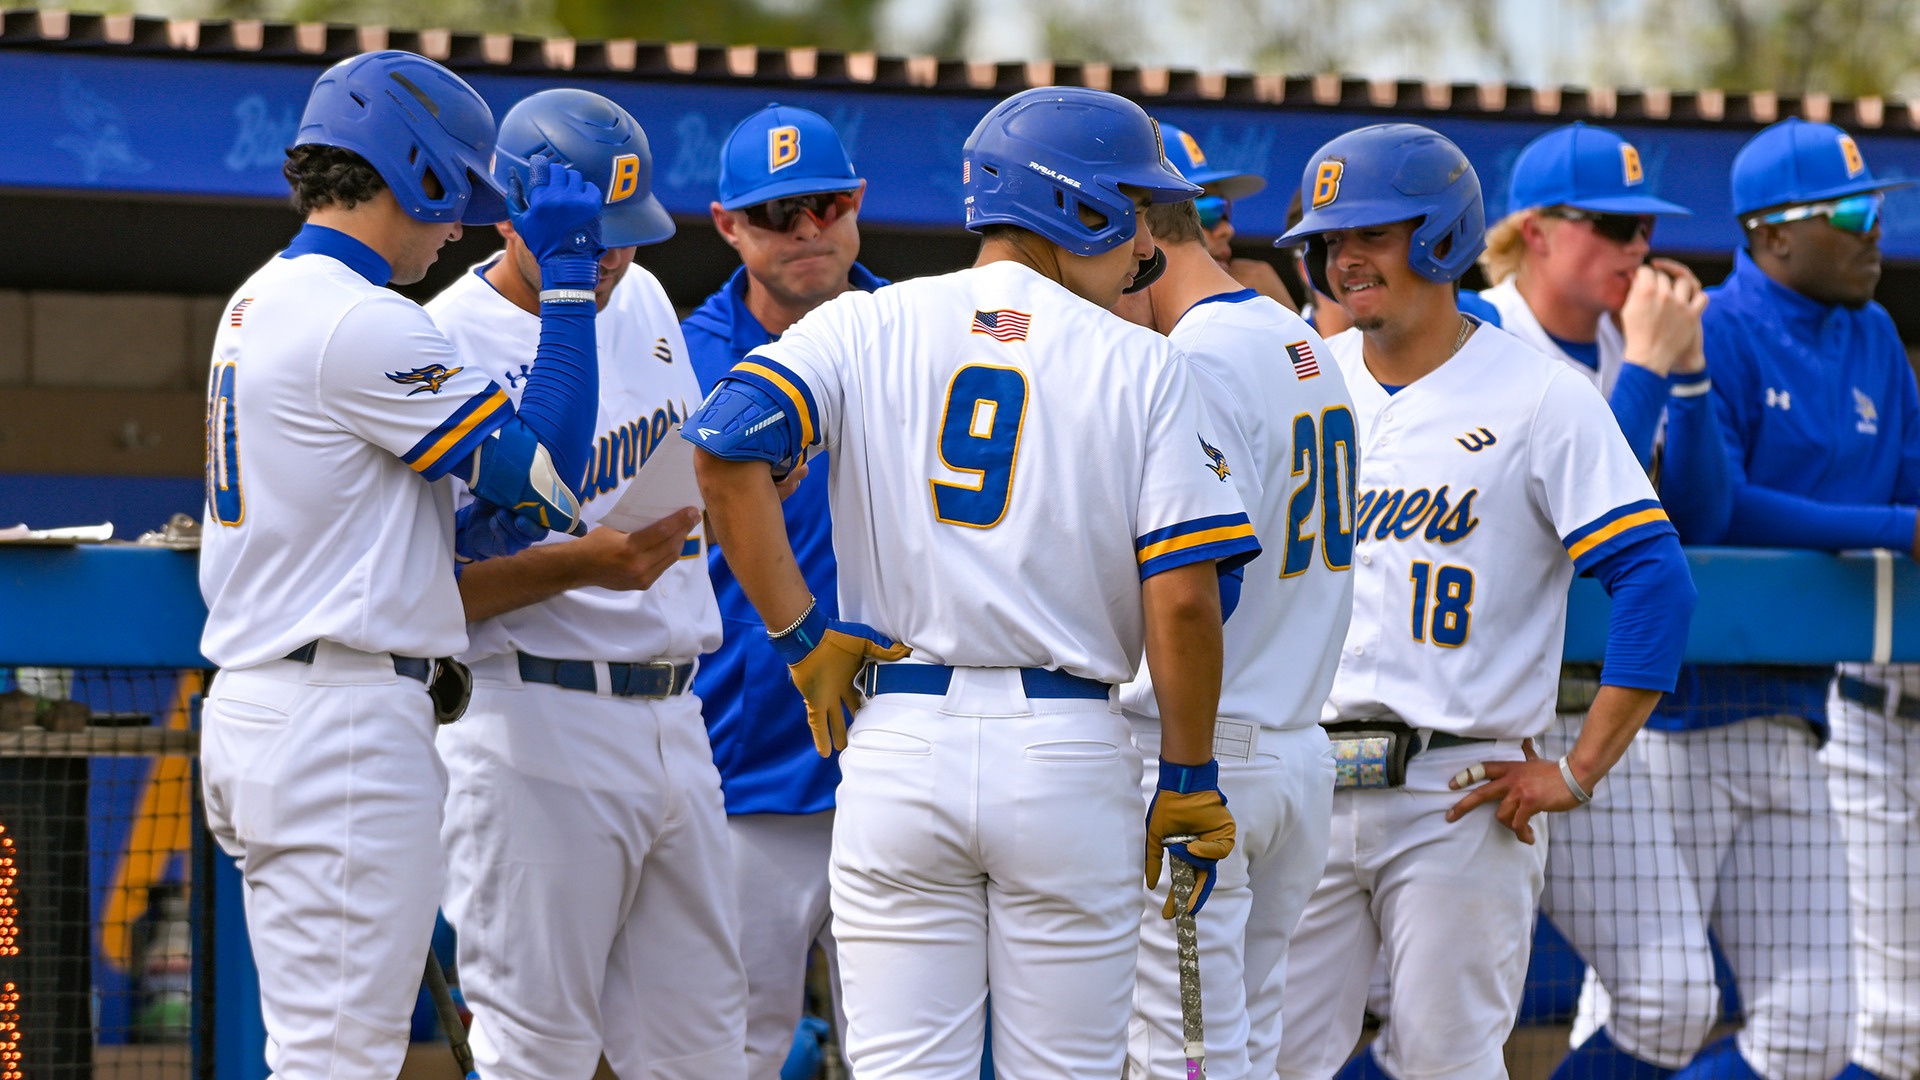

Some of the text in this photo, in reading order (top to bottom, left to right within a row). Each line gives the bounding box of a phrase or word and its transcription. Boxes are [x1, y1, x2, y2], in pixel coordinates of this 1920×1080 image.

[767, 125, 801, 174] B
[1618, 142, 1644, 187] B
[1837, 133, 1864, 180] B
[606, 154, 640, 204] B
[1028, 160, 1082, 189] RAWLINGS
[1312, 162, 1344, 210] B
[928, 362, 1030, 530] 9
[1279, 403, 1356, 579] 20
[1409, 559, 1476, 649] 18
